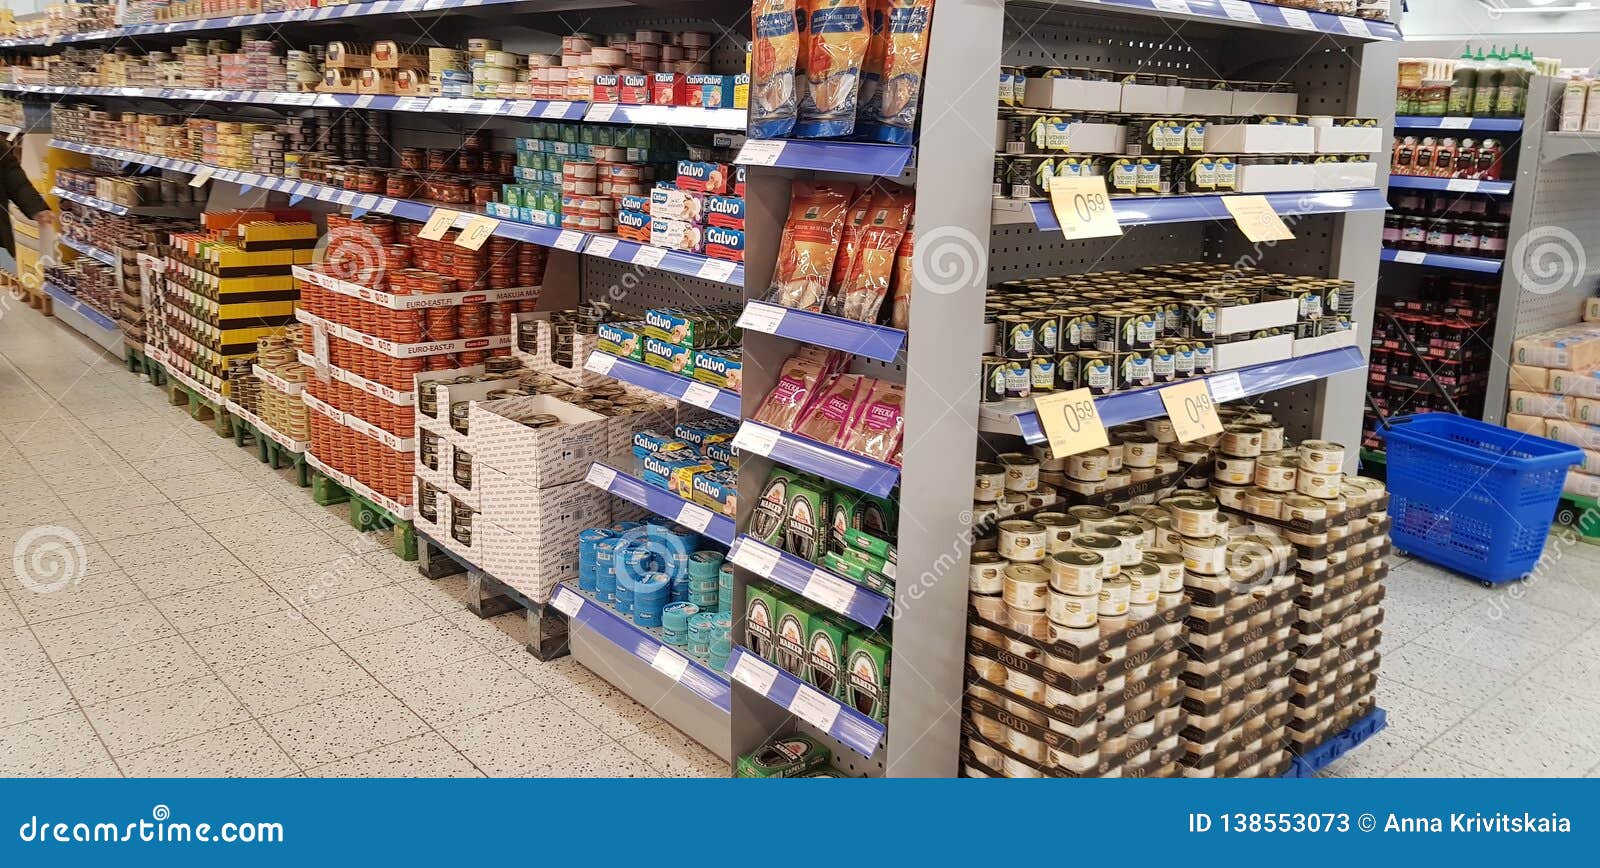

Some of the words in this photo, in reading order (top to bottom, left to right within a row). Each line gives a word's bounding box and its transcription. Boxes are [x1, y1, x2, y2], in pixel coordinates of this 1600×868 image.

[596, 75, 616, 86] Calvo
[625, 75, 644, 86] Calvo
[655, 72, 673, 83] Calvo
[686, 75, 703, 85] Calvo
[704, 75, 721, 85] Calvo
[678, 162, 704, 178] Calvo
[622, 197, 641, 210] Calvo
[710, 198, 740, 215] Calvo
[618, 213, 642, 227] Calvo
[708, 229, 739, 246] Calvo
[496, 291, 524, 300] MAKUJA
[646, 312, 672, 330] Calvo
[598, 326, 622, 343] Calvo
[647, 339, 672, 358] Calvo
[696, 353, 726, 373] Calvo
[634, 434, 658, 452] Calvo
[675, 426, 701, 444] Calvo
[644, 457, 670, 476] Calvo
[693, 478, 721, 498] Calvo
[1127, 620, 1150, 640] GOLD
[998, 651, 1029, 671] GOLD
[1124, 651, 1148, 671] GOLD
[1123, 680, 1146, 700] GOLD
[997, 711, 1029, 733] GOLD
[1124, 709, 1146, 729] GOLD
[1126, 738, 1149, 759] GOLD
